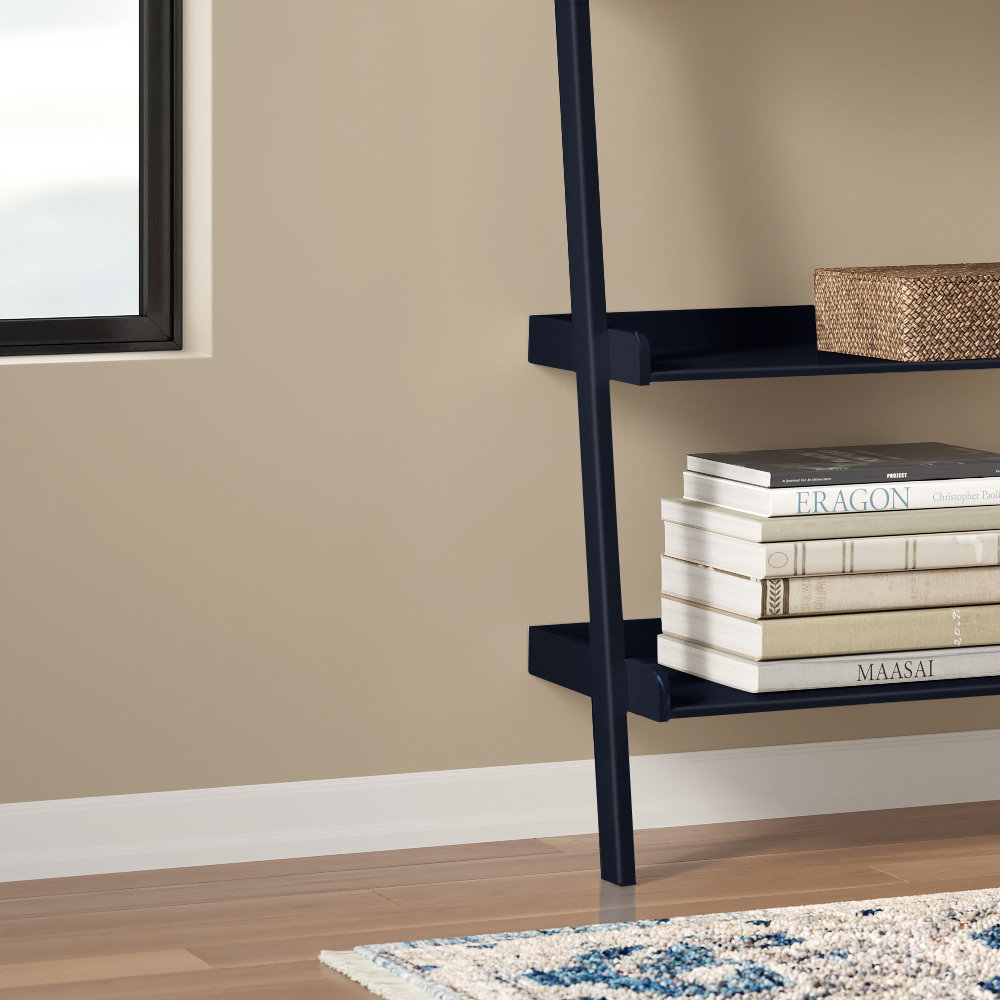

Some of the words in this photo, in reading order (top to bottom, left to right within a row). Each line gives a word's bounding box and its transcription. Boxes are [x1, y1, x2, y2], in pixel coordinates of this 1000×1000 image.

[796, 487, 911, 514] ERAGON
[932, 491, 980, 503] Christopher
[857, 659, 934, 682] MAASAI
